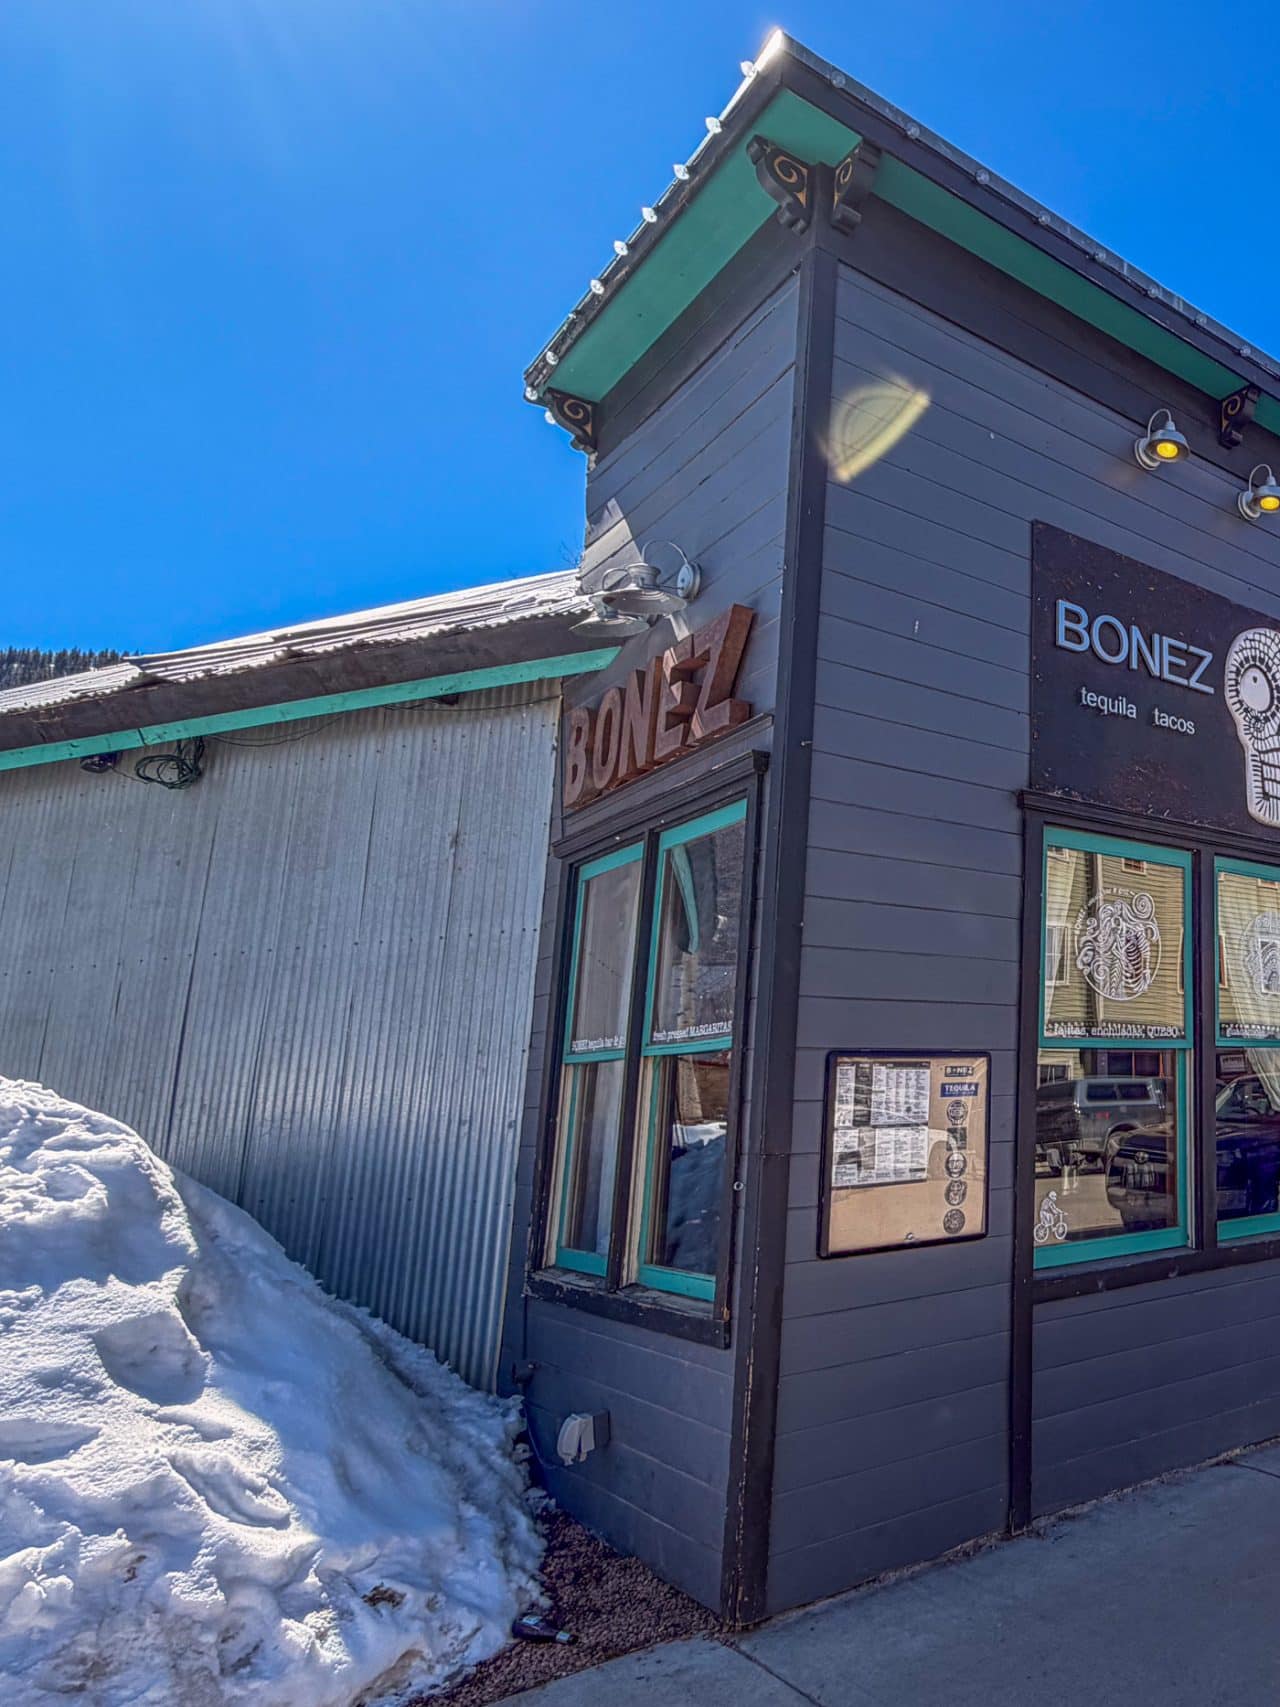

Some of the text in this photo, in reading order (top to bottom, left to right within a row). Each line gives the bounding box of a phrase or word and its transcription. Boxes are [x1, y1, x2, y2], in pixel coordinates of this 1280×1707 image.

[1055, 599, 1215, 696] BONEZ
[564, 603, 756, 808] BONEZ
[1081, 687, 1195, 735] tequila tacos
[1147, 1025, 1178, 1038] QUESO
[944, 1083, 976, 1092] TEQUILA
